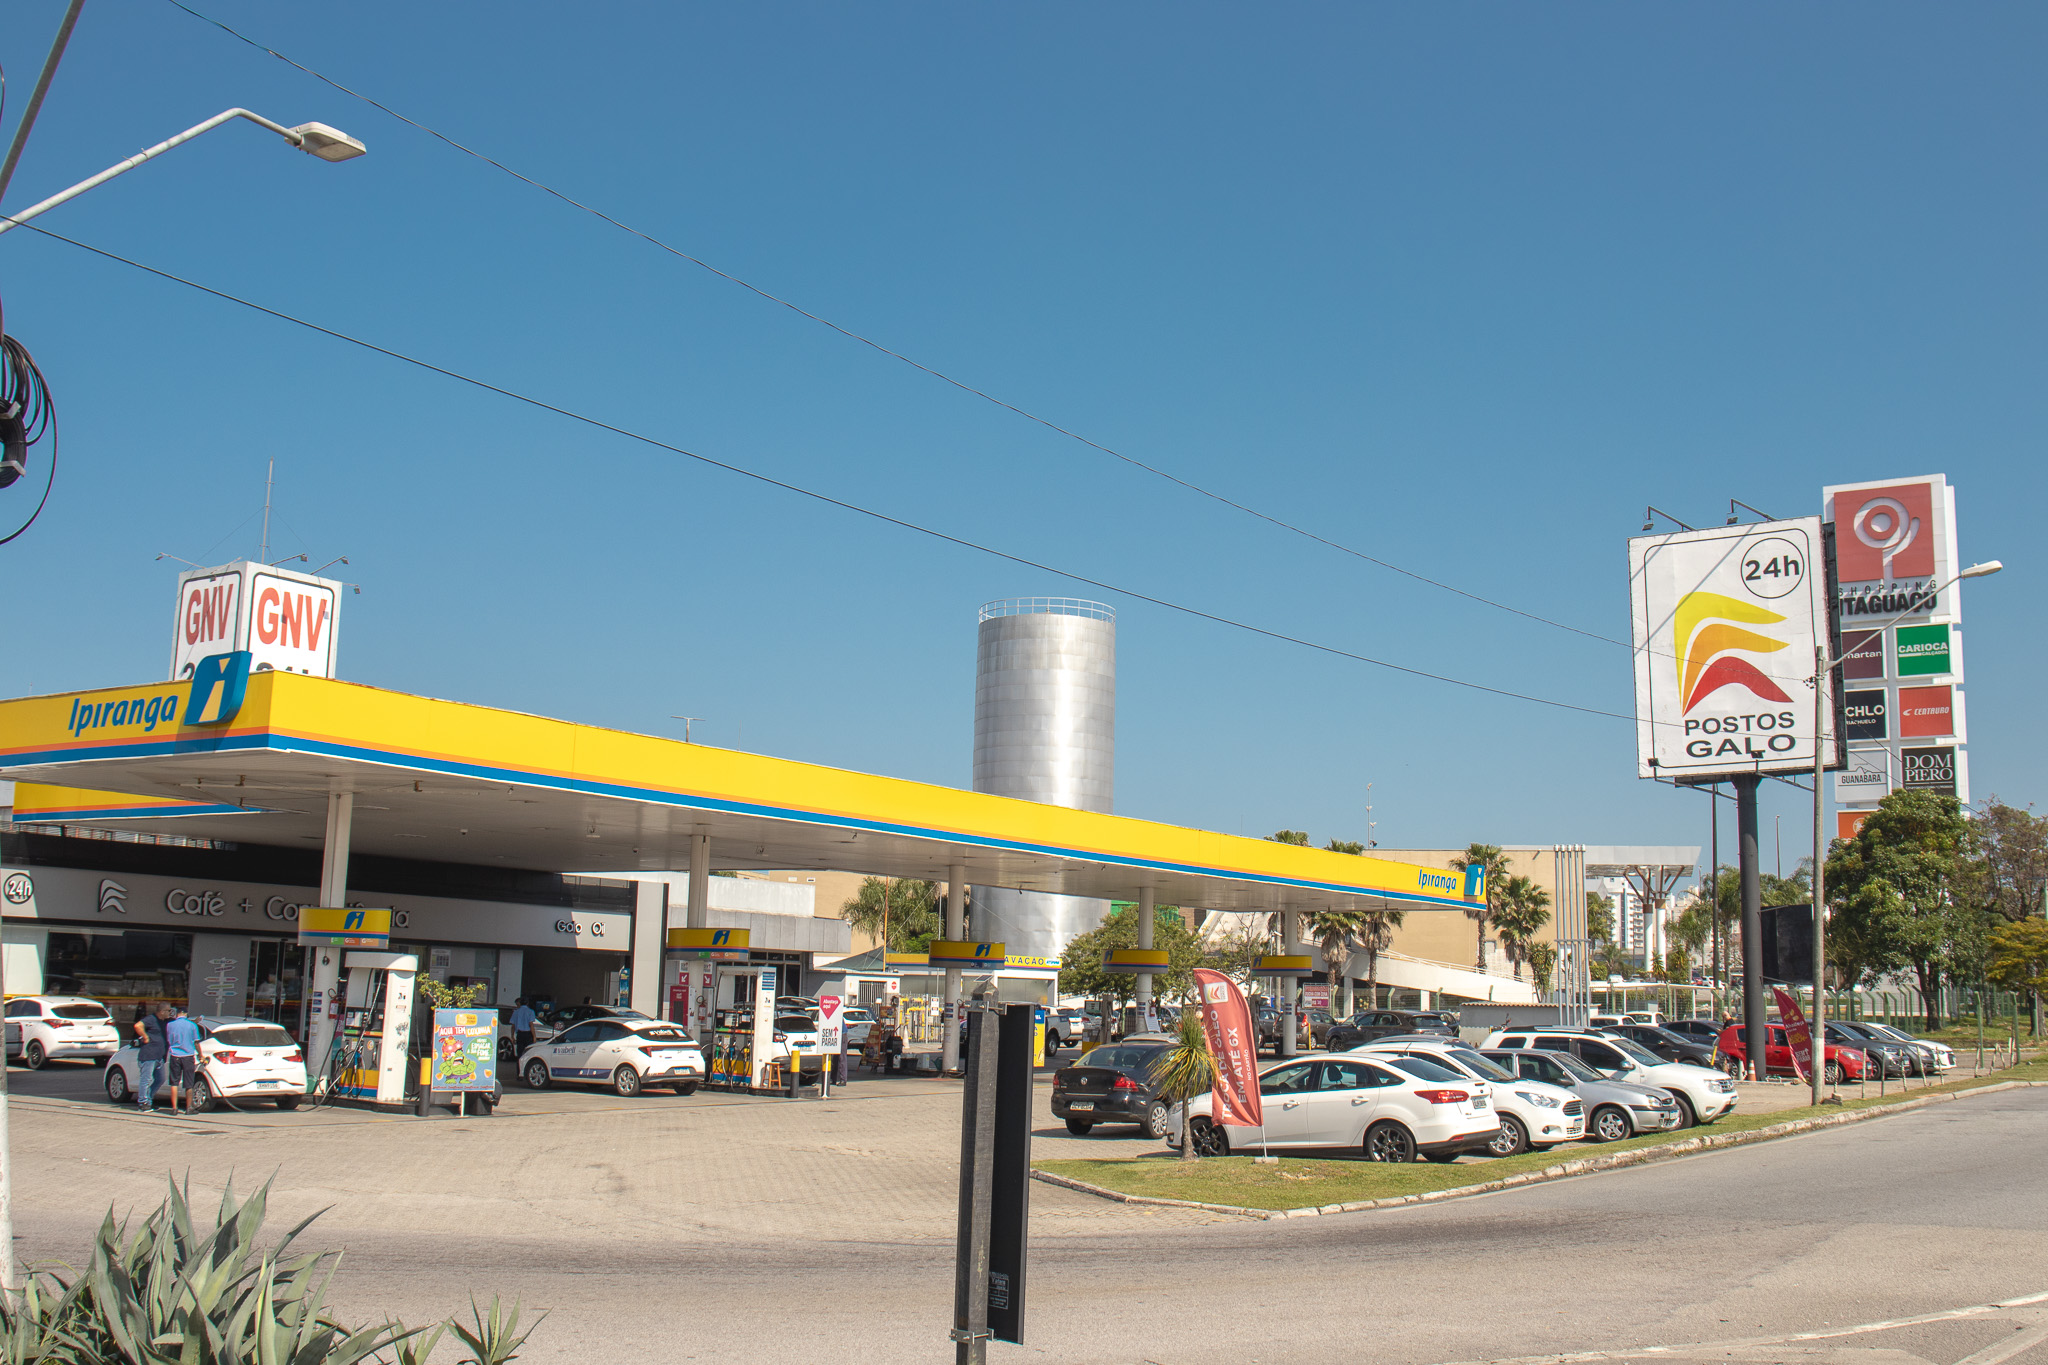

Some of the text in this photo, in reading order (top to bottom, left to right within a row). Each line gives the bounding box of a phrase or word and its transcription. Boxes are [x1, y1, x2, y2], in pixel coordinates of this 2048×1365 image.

[1745, 555, 1800, 581] 24h
[1838, 579, 1937, 597] SHOPPING
[186, 584, 234, 645] GNV
[257, 587, 328, 651] GNV
[1844, 650, 1882, 659] martan
[1898, 642, 1949, 653] CARIOCA
[68, 695, 179, 738] Ipiranga
[1845, 704, 1885, 717] CHLO
[1914, 706, 1949, 716] CENTAURO
[1684, 711, 1795, 736] POSTOS
[1686, 733, 1796, 758] GALO
[1904, 754, 1953, 769] DOM
[1841, 774, 1882, 784] GUANABARA
[8, 880, 31, 897] 24h
[1418, 868, 1457, 893] Ipiranga
[166, 888, 226, 917] Café
[556, 919, 582, 935] Galo
[439, 1027, 453, 1036] AQUI
[455, 1026, 466, 1035] TEM
[822, 1028, 833, 1037] SEM
[821, 1038, 838, 1047] PARAR
[1218, 1051, 1228, 1070] DE
[1227, 1027, 1247, 1104] EM ATÉ 6X
[1247, 1072, 1252, 1081] NO
[1220, 1072, 1232, 1120] TROCA
